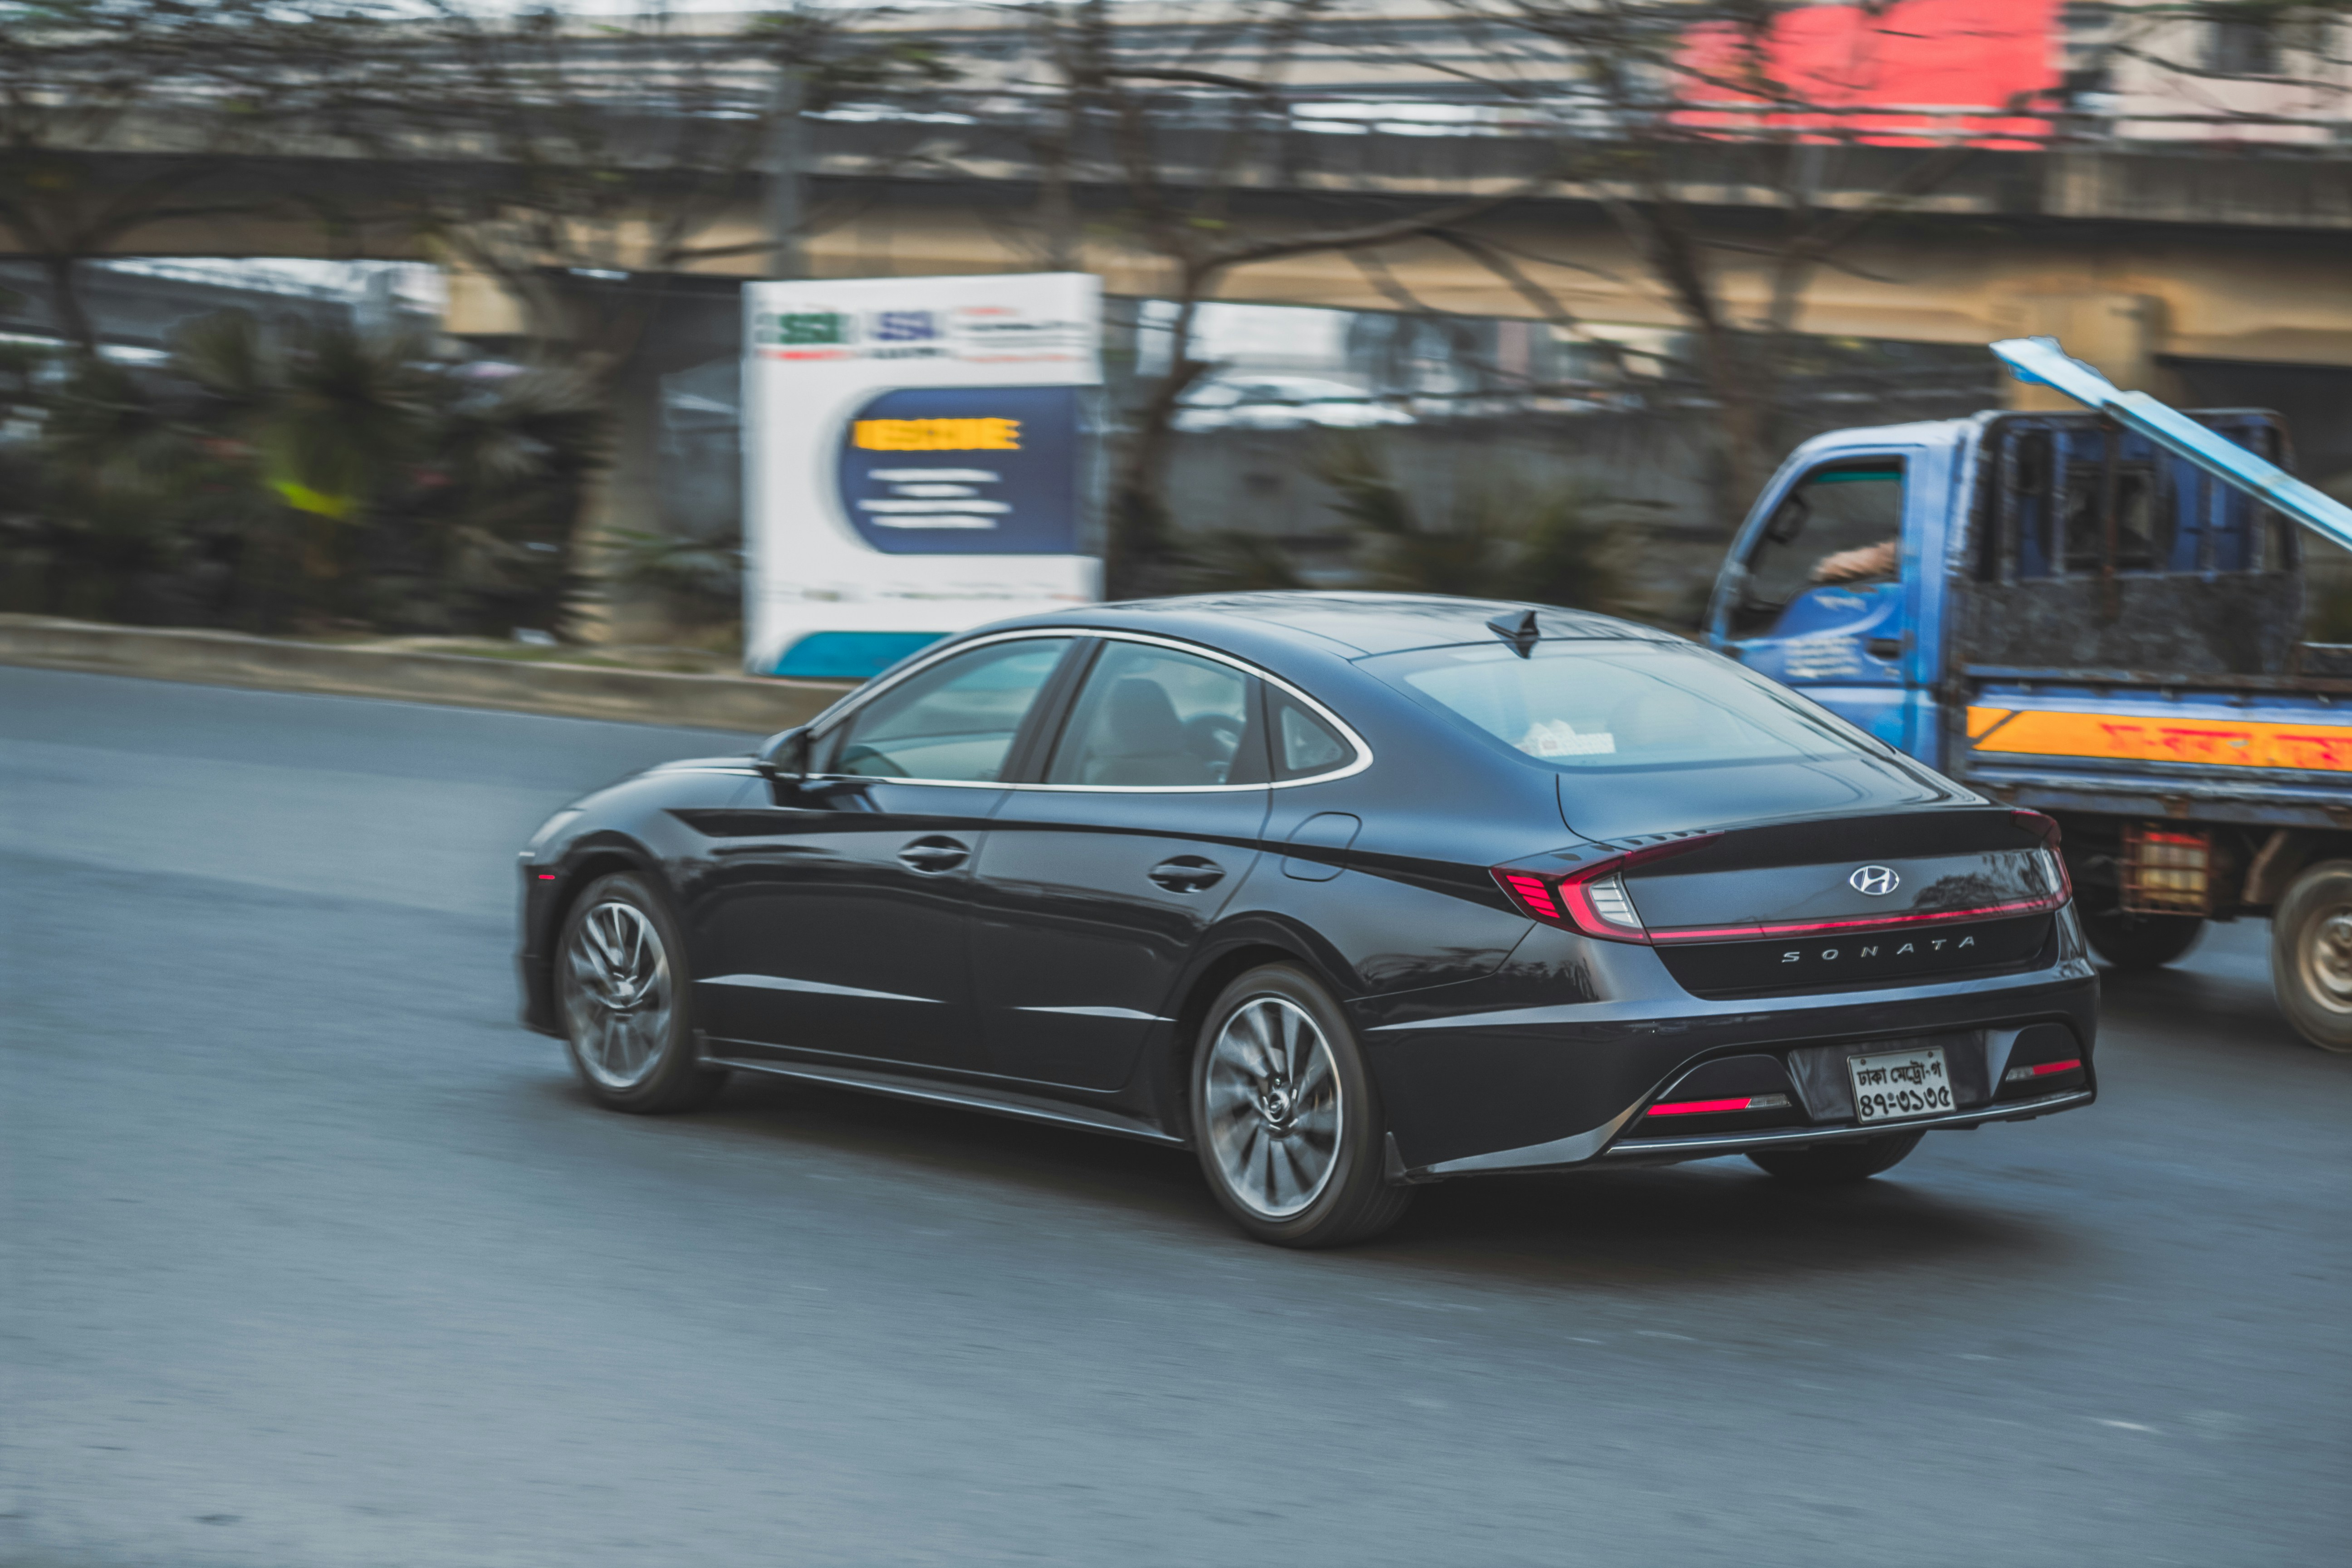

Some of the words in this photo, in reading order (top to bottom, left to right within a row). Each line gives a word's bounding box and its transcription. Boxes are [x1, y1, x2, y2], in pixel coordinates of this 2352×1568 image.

[1781, 936, 1975, 963] SONATA
[1857, 1066, 1887, 1086] ঢাকা
[1860, 1085, 1951, 1117] ৪৭-৩১৩৫
